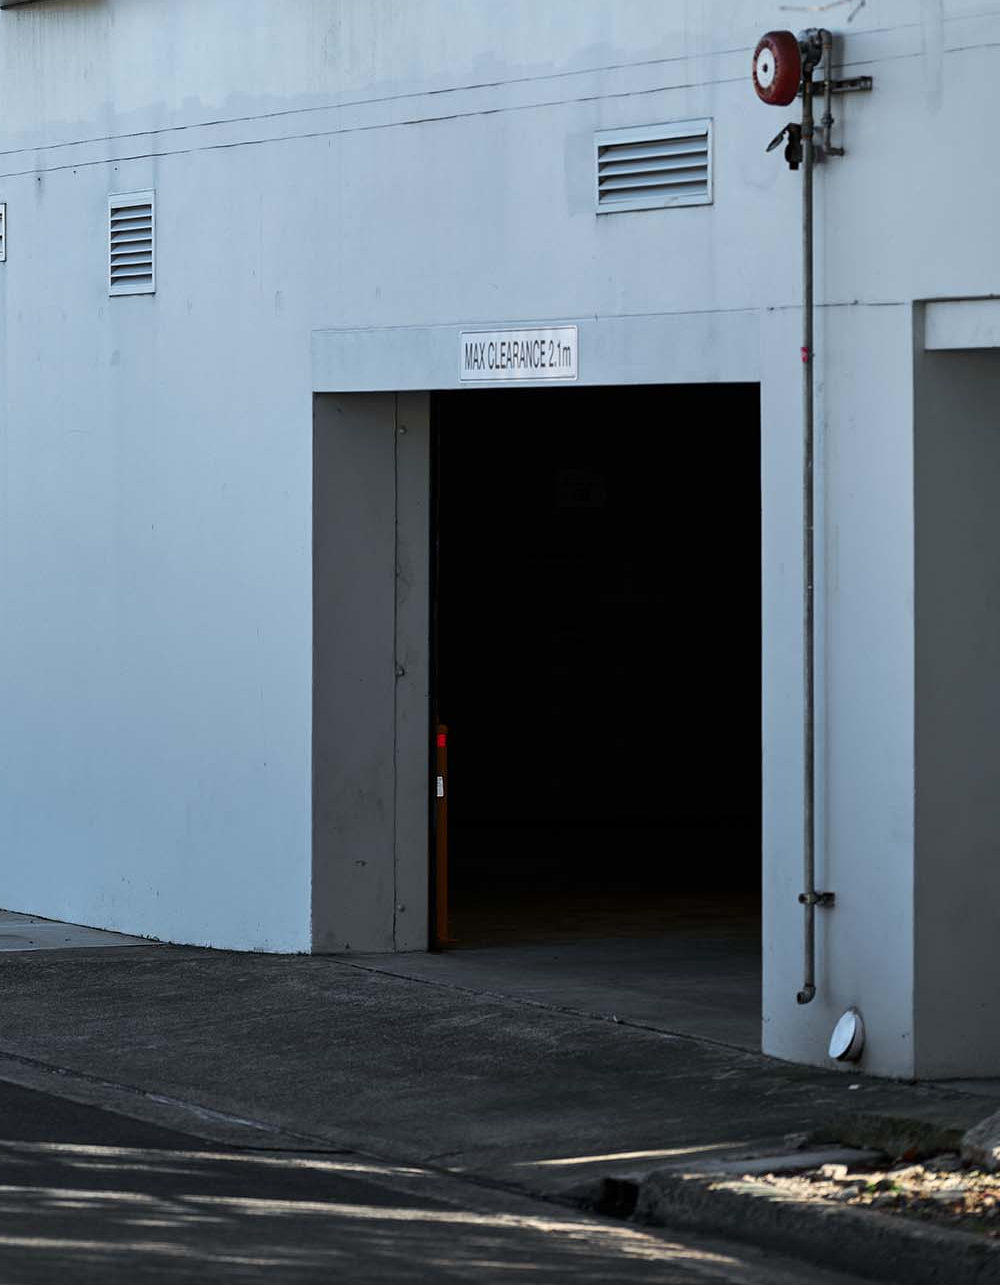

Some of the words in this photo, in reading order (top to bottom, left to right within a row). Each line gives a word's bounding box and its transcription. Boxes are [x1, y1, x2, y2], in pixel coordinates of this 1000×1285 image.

[465, 342, 485, 370] MAX
[488, 340, 545, 370] CLEARANCE
[548, 340, 571, 367] 2.1m
